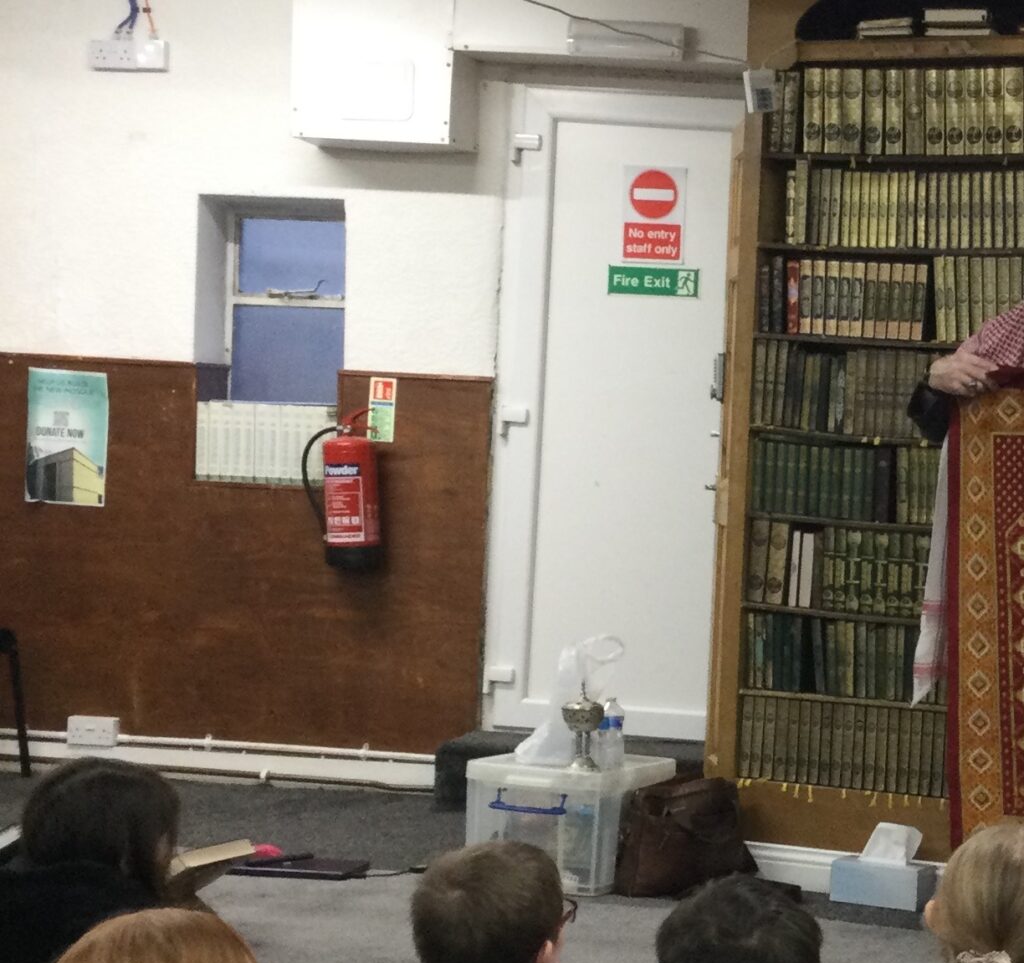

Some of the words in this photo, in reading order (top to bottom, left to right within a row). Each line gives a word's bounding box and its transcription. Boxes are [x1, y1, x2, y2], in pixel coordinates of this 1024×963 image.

[628, 228, 644, 239] No
[647, 229, 676, 242] entry
[626, 243, 652, 254] staff
[654, 244, 678, 257] only
[613, 274, 639, 287] Fire
[643, 276, 671, 288] Exit
[36, 426, 64, 438] DONATE
[67, 428, 84, 439] NOW
